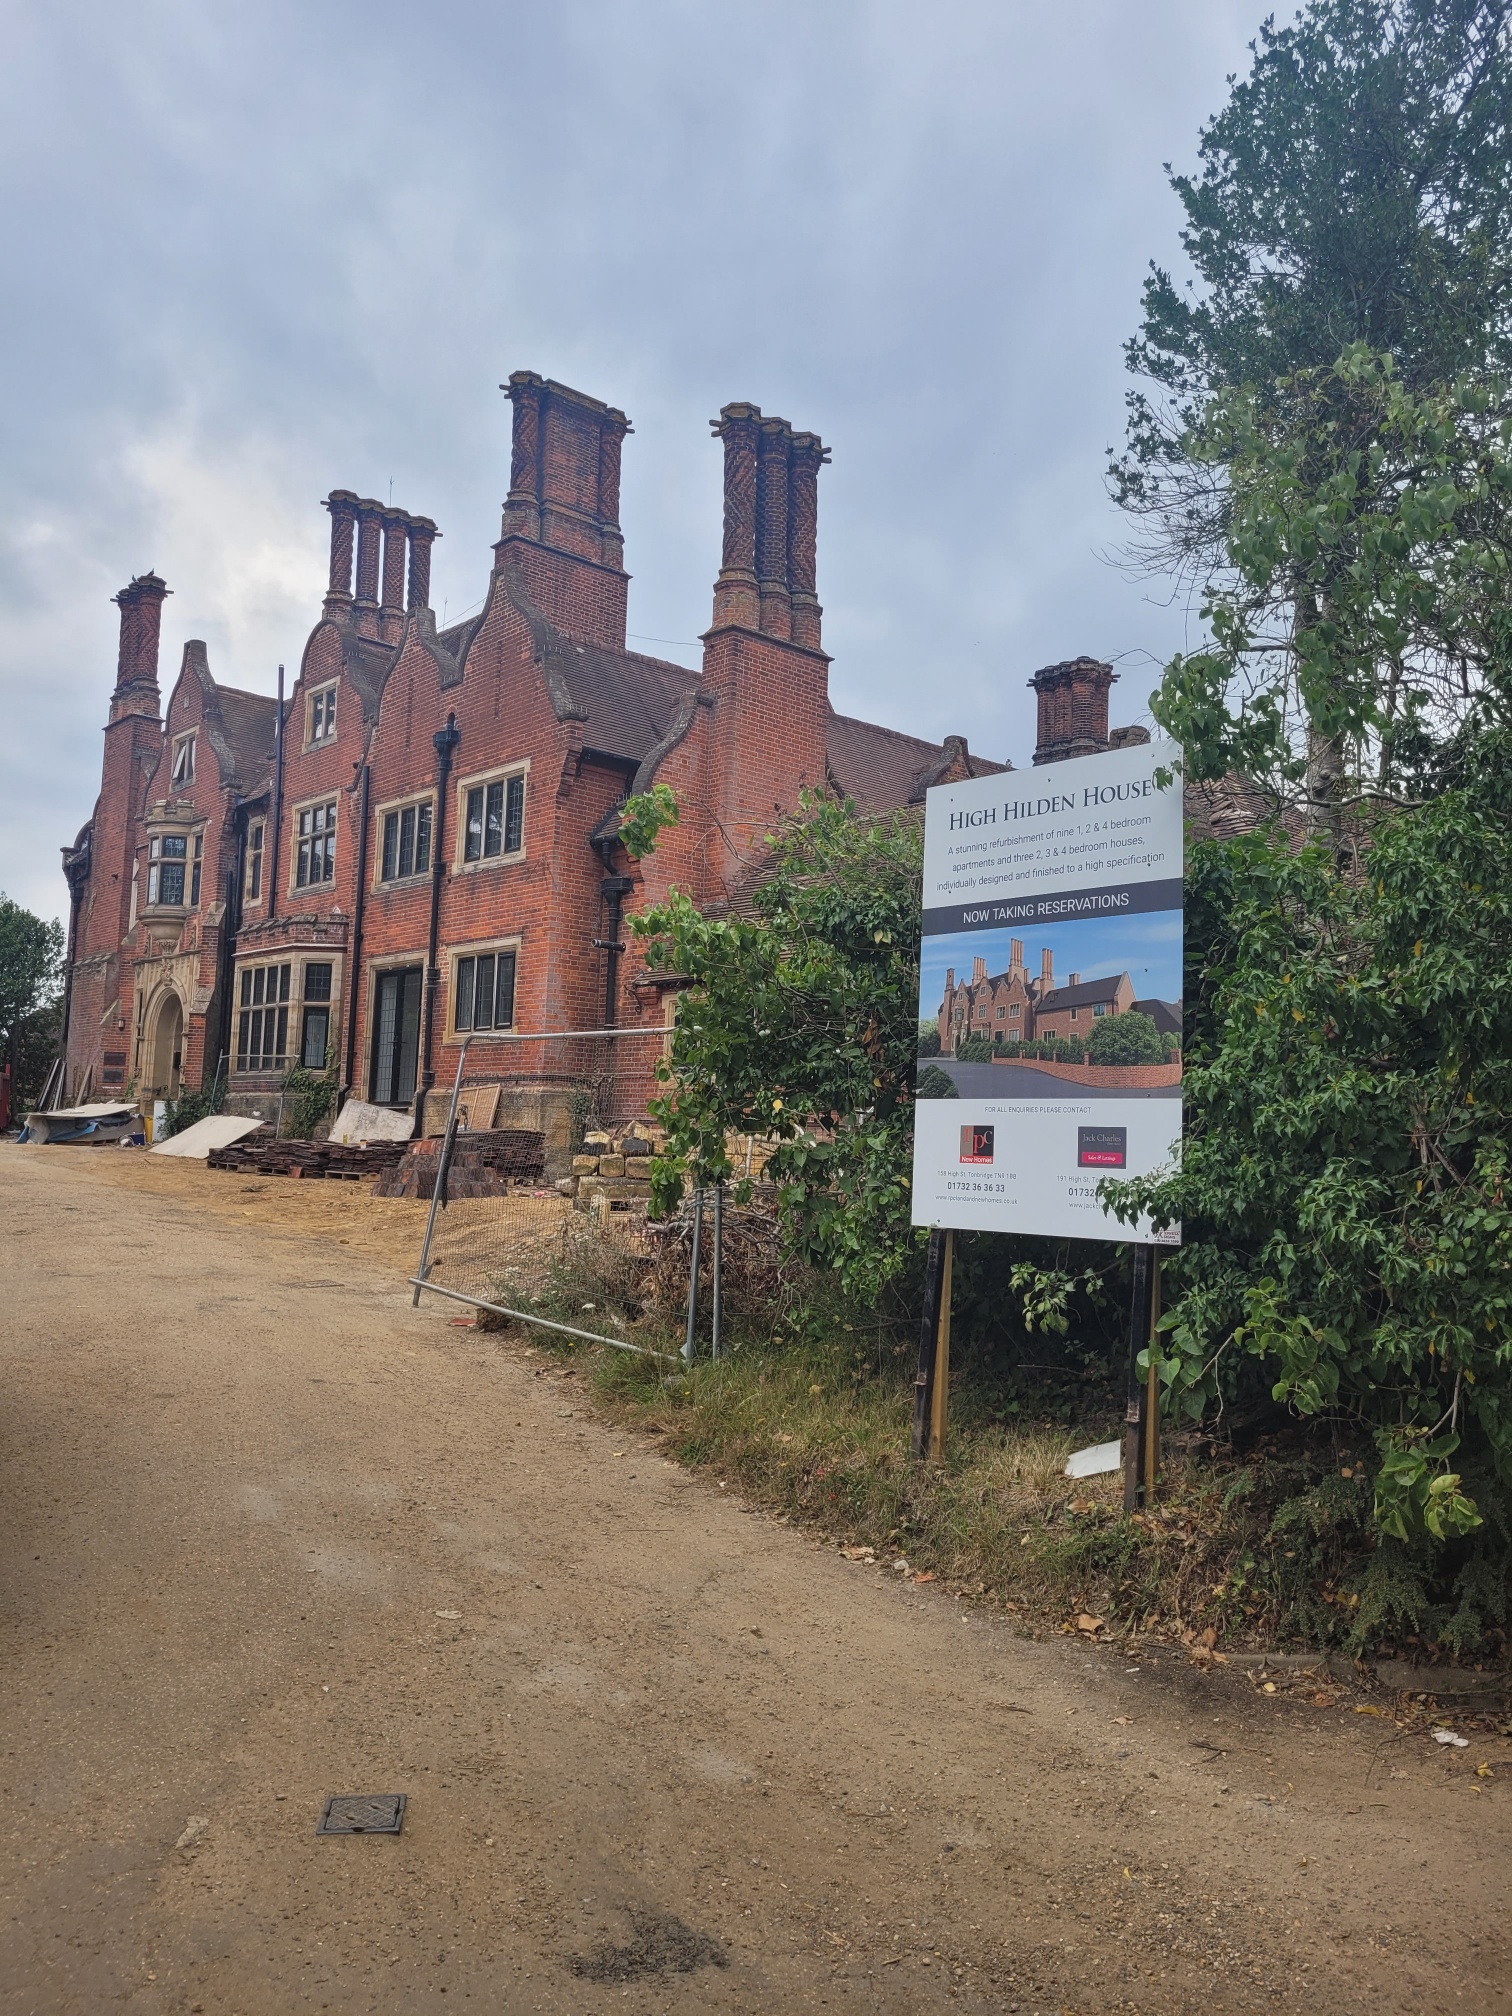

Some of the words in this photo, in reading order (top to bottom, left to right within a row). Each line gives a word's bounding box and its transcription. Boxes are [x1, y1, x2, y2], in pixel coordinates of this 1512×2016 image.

[949, 807, 997, 831] HIGH
[1003, 793, 1076, 821] HILDEN
[1082, 779, 1152, 808] HOUSE
[947, 846, 954, 856] A
[955, 842, 988, 855] stunning
[989, 832, 1044, 849] refurbishment
[1045, 829, 1055, 840] of
[1056, 828, 1074, 838] nine
[1076, 825, 1083, 836] 1,
[1085, 823, 1091, 834] 2
[1093, 822, 1100, 832] &
[1102, 821, 1108, 831] 4
[1110, 816, 1152, 830] bedroom
[952, 858, 995, 873] apartments
[997, 854, 1012, 865] and
[1013, 852, 1034, 863] three
[1035, 849, 1043, 860] 2,
[1045, 848, 1051, 858] 3
[1052, 847, 1059, 857] &
[1061, 846, 1067, 855] 4
[1069, 841, 1108, 855] bedroom
[1110, 836, 1145, 849] houses,
[936, 877, 977, 891] individually
[978, 872, 1013, 886] designed
[1015, 869, 1030, 880] and
[1032, 864, 1065, 878] finished
[1066, 864, 1075, 873] to
[1077, 864, 1083, 872] a
[1085, 859, 1104, 872] high
[1106, 852, 1165, 869] specification
[963, 909, 990, 924] NOW
[992, 904, 1034, 920] TAKING
[1037, 892, 1130, 915] RESERVATIONS
[1008, 1106, 1039, 1114] ENQUIRIES
[1062, 1106, 1092, 1114] CONTACT
[1082, 1133, 1096, 1143] Jack
[1096, 1133, 1122, 1142] Charles
[961, 1155, 974, 1163] New
[974, 1156, 993, 1164] Homes
[968, 1171, 993, 1180] Tonbridge
[1068, 1176, 1082, 1184] High
[947, 1181, 970, 1191] 01732
[972, 1183, 982, 1191] 36
[983, 1183, 993, 1192] 36
[995, 1184, 1005, 1193] 33
[1068, 1187, 1095, 1197] 01732
